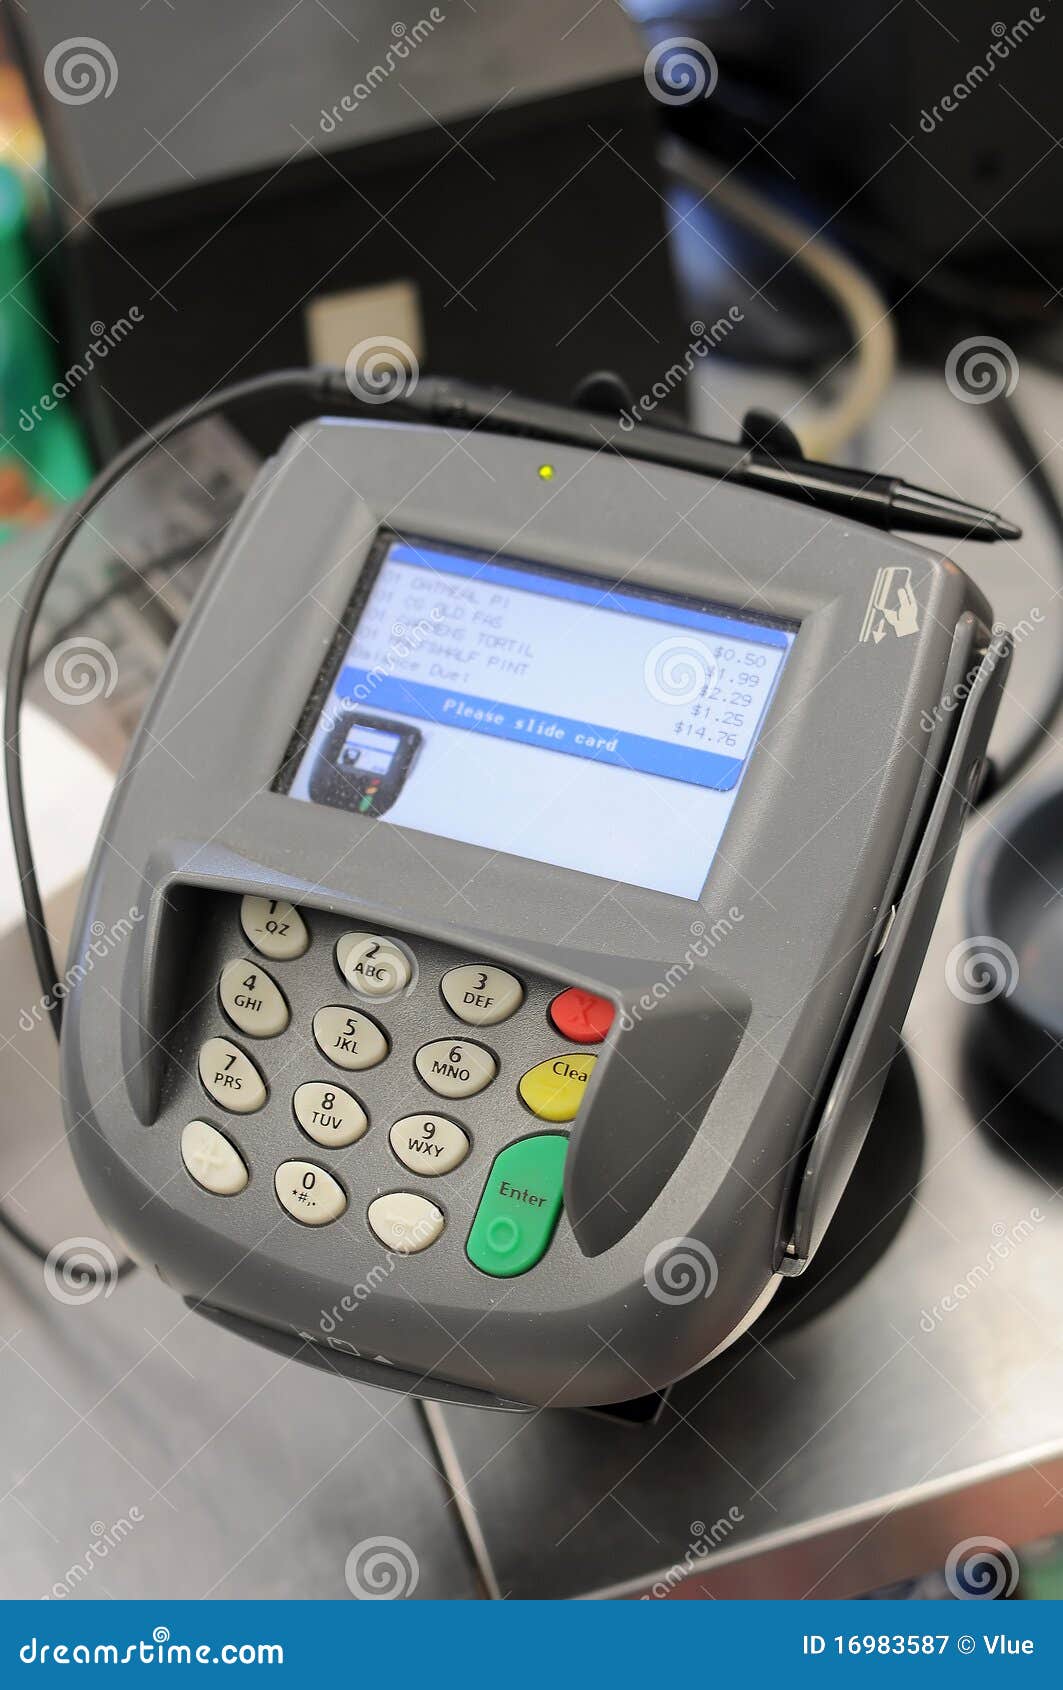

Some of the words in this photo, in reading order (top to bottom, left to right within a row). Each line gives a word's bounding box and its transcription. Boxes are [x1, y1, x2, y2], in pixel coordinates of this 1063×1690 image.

[713, 646, 767, 668] $0.50
[699, 684, 753, 707] $2.29
[690, 704, 745, 727] $1.25
[442, 698, 505, 726] Please
[513, 717, 565, 740] slide
[575, 731, 619, 753] card
[673, 720, 737, 748] $14.76
[366, 942, 381, 959] 2
[353, 962, 387, 982] ABC
[242, 974, 258, 991] 4
[473, 973, 488, 991] 3
[233, 994, 263, 1012] GHI
[463, 992, 495, 1009] DEF
[343, 1018, 356, 1036] 5
[333, 1037, 359, 1055] JKL
[449, 1045, 462, 1063] 6
[223, 1053, 238, 1071] 7
[431, 1061, 471, 1082] MNO
[552, 1061, 589, 1082] Clea
[214, 1072, 243, 1091] PRS
[321, 1092, 336, 1110] 8
[311, 1111, 343, 1131] TUV
[422, 1121, 436, 1140] 9
[408, 1138, 446, 1158] WXY
[301, 1171, 317, 1190] 0
[499, 1181, 548, 1209] Enter
